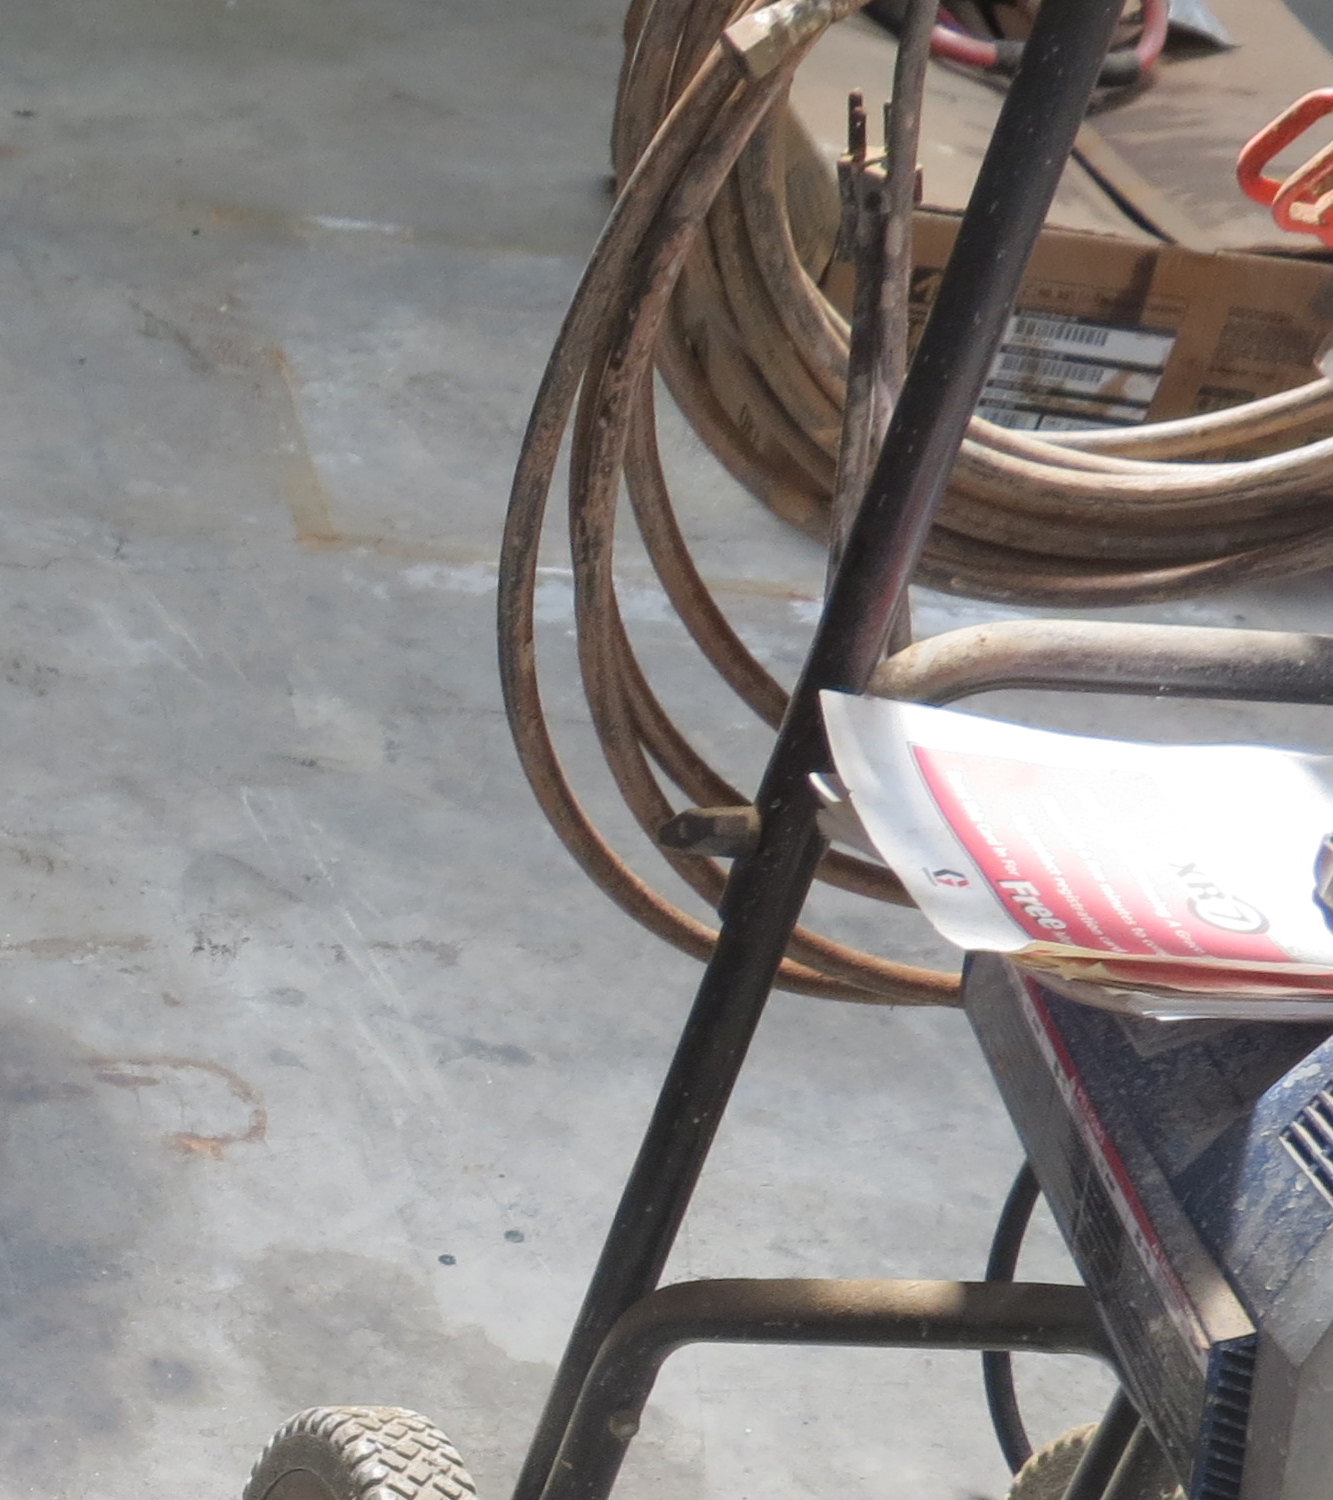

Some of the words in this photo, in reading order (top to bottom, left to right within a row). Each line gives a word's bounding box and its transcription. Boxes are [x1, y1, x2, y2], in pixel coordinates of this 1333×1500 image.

[1001, 859, 1021, 876] For
[998, 881, 1067, 928] Free
[1054, 878, 1103, 937] registration
[1099, 883, 1136, 925] minutes
